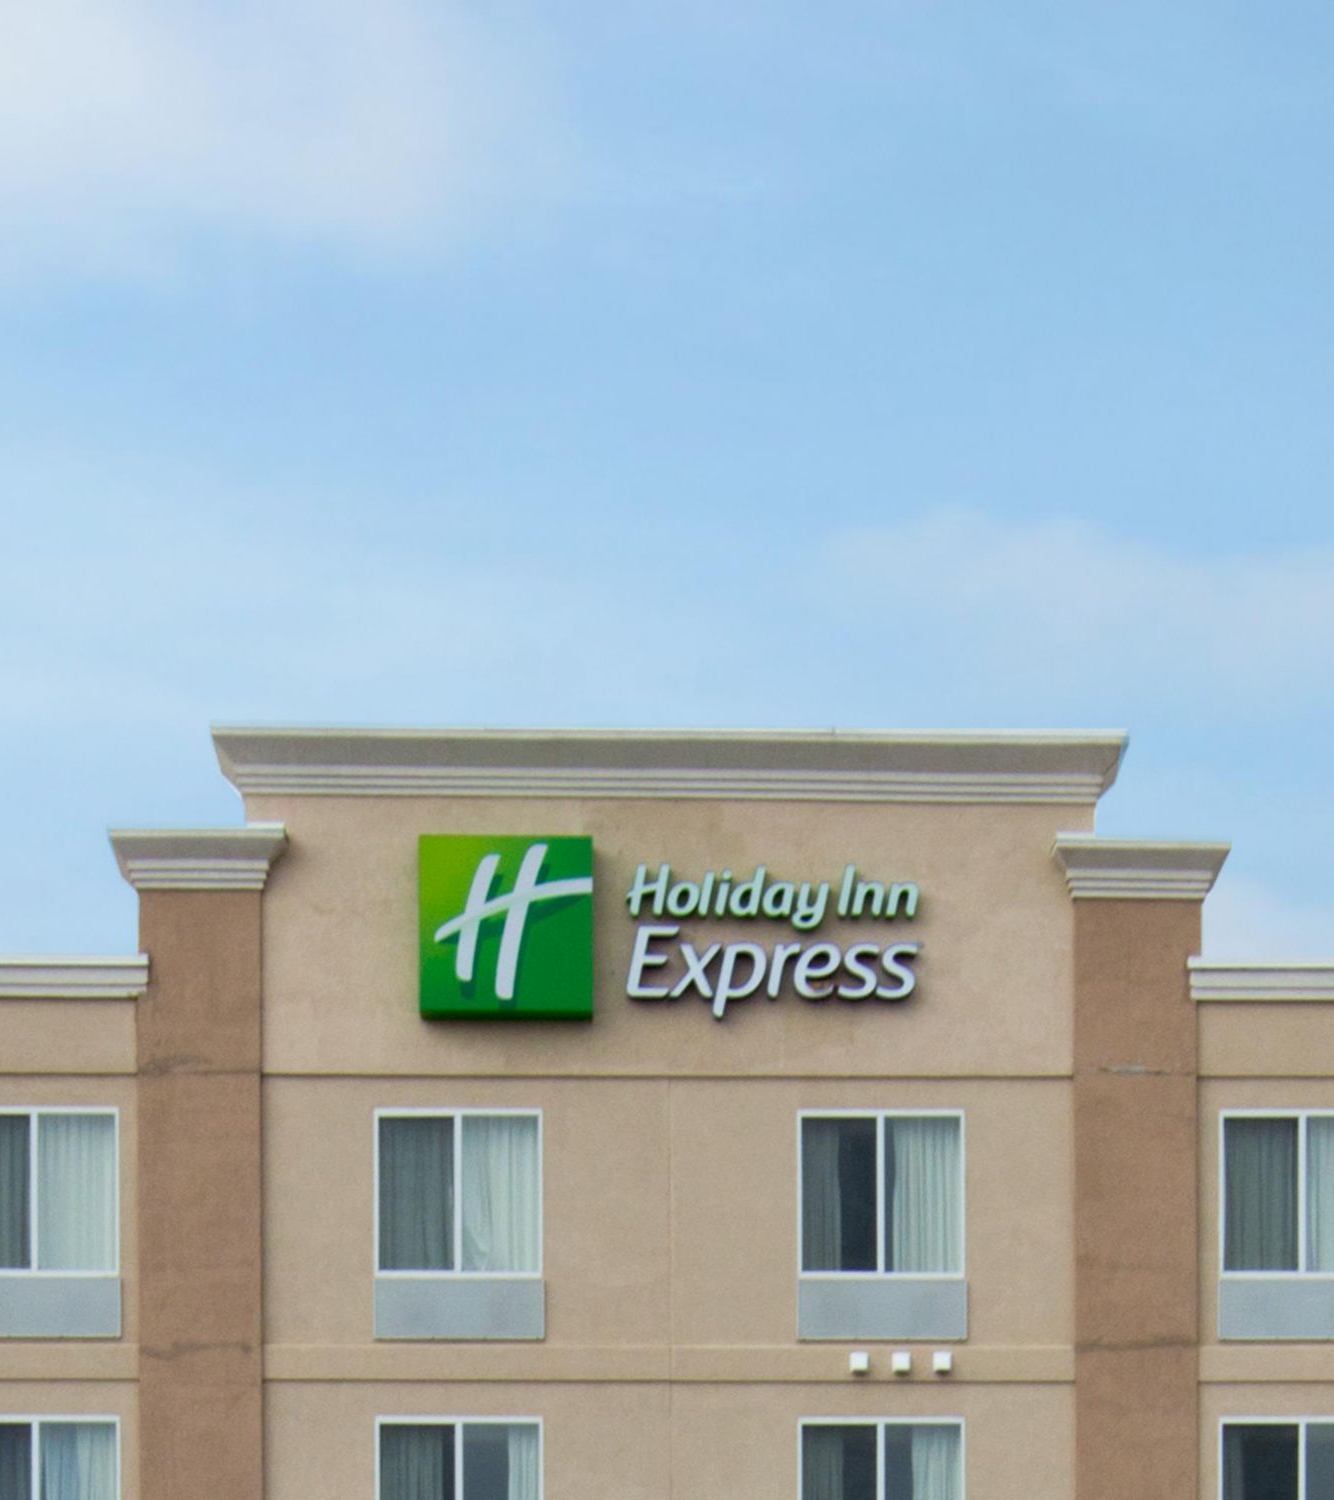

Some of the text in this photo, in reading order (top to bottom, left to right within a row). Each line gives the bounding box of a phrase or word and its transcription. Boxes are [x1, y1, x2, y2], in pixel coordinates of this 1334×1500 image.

[626, 863, 921, 930] Holiday Inn
[625, 924, 920, 1019] Express
